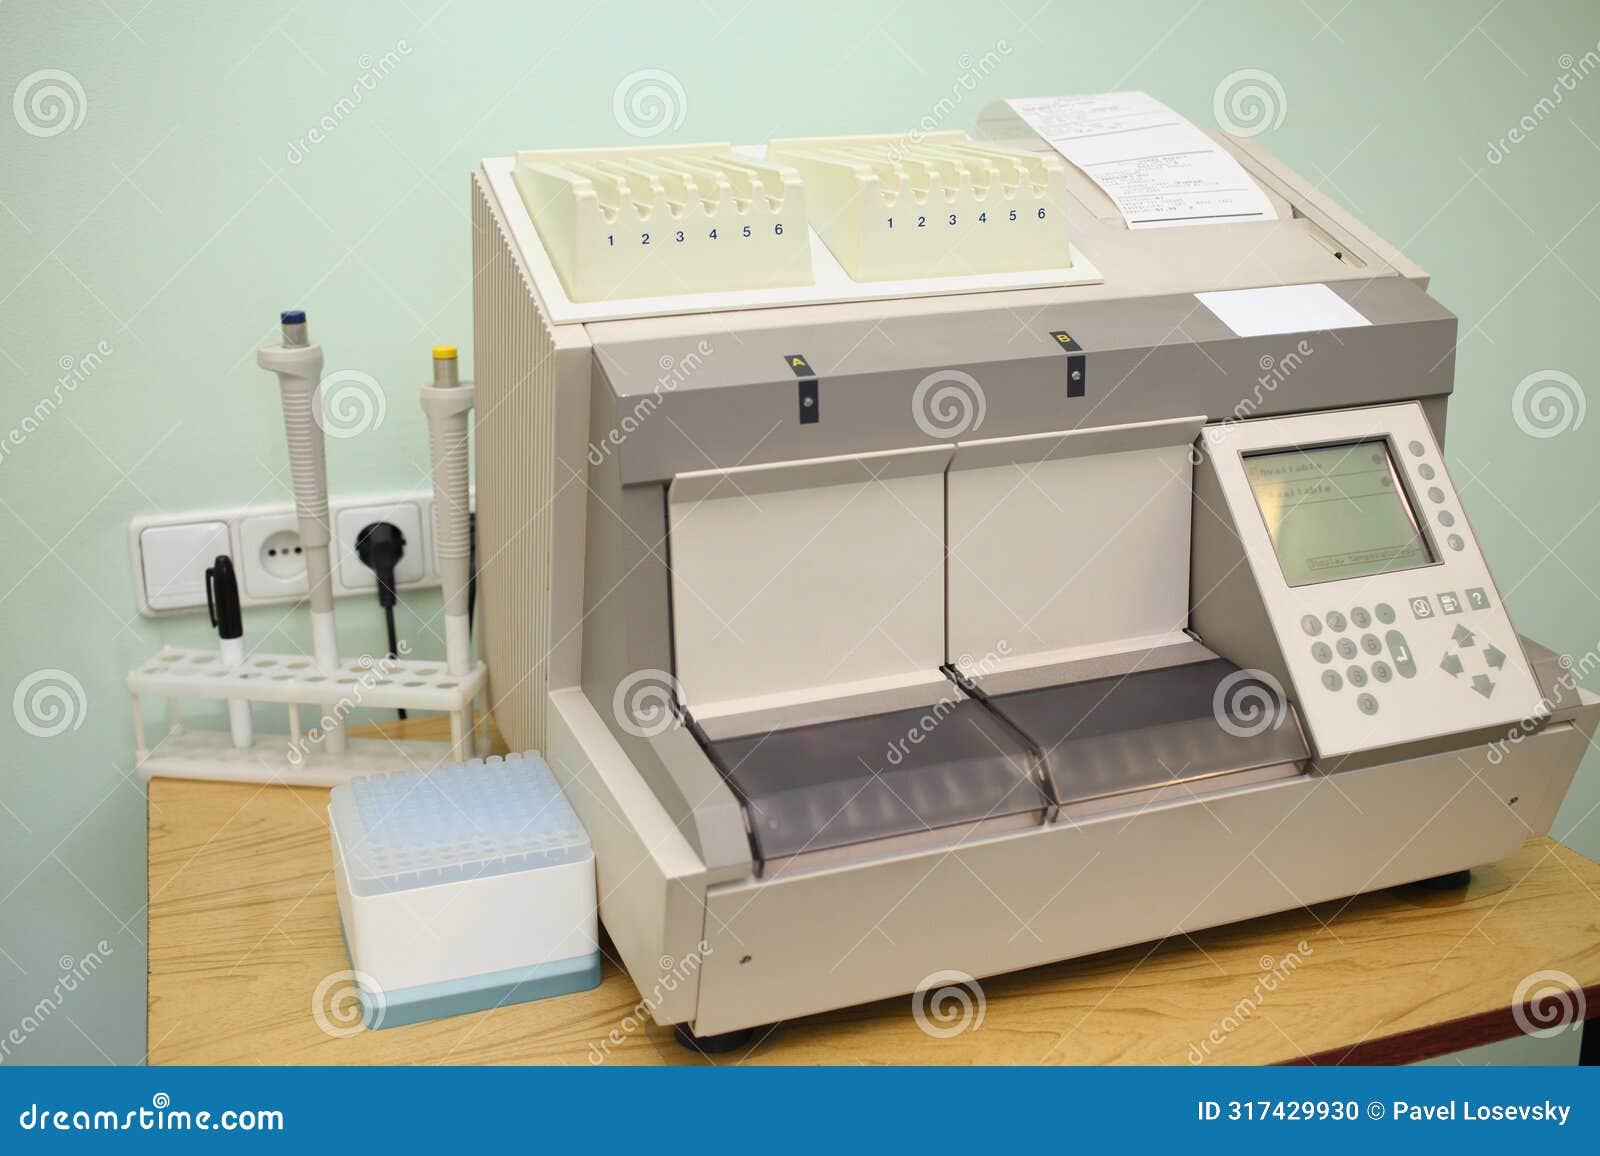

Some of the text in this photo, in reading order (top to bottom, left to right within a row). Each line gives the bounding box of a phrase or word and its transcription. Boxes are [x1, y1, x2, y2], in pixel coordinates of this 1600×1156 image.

[887, 208, 1046, 228] 1 2 3 4 5 6
[607, 223, 783, 246] 1 2 3 4 5 6
[1056, 334, 1071, 343] B
[792, 357, 806, 367] A
[1331, 616, 1344, 628] 2
[1356, 612, 1367, 624] 3
[1342, 642, 1353, 656] 5
[1367, 639, 1377, 650] 6
[1352, 670, 1362, 683] 8
[1377, 666, 1387, 679] 9
